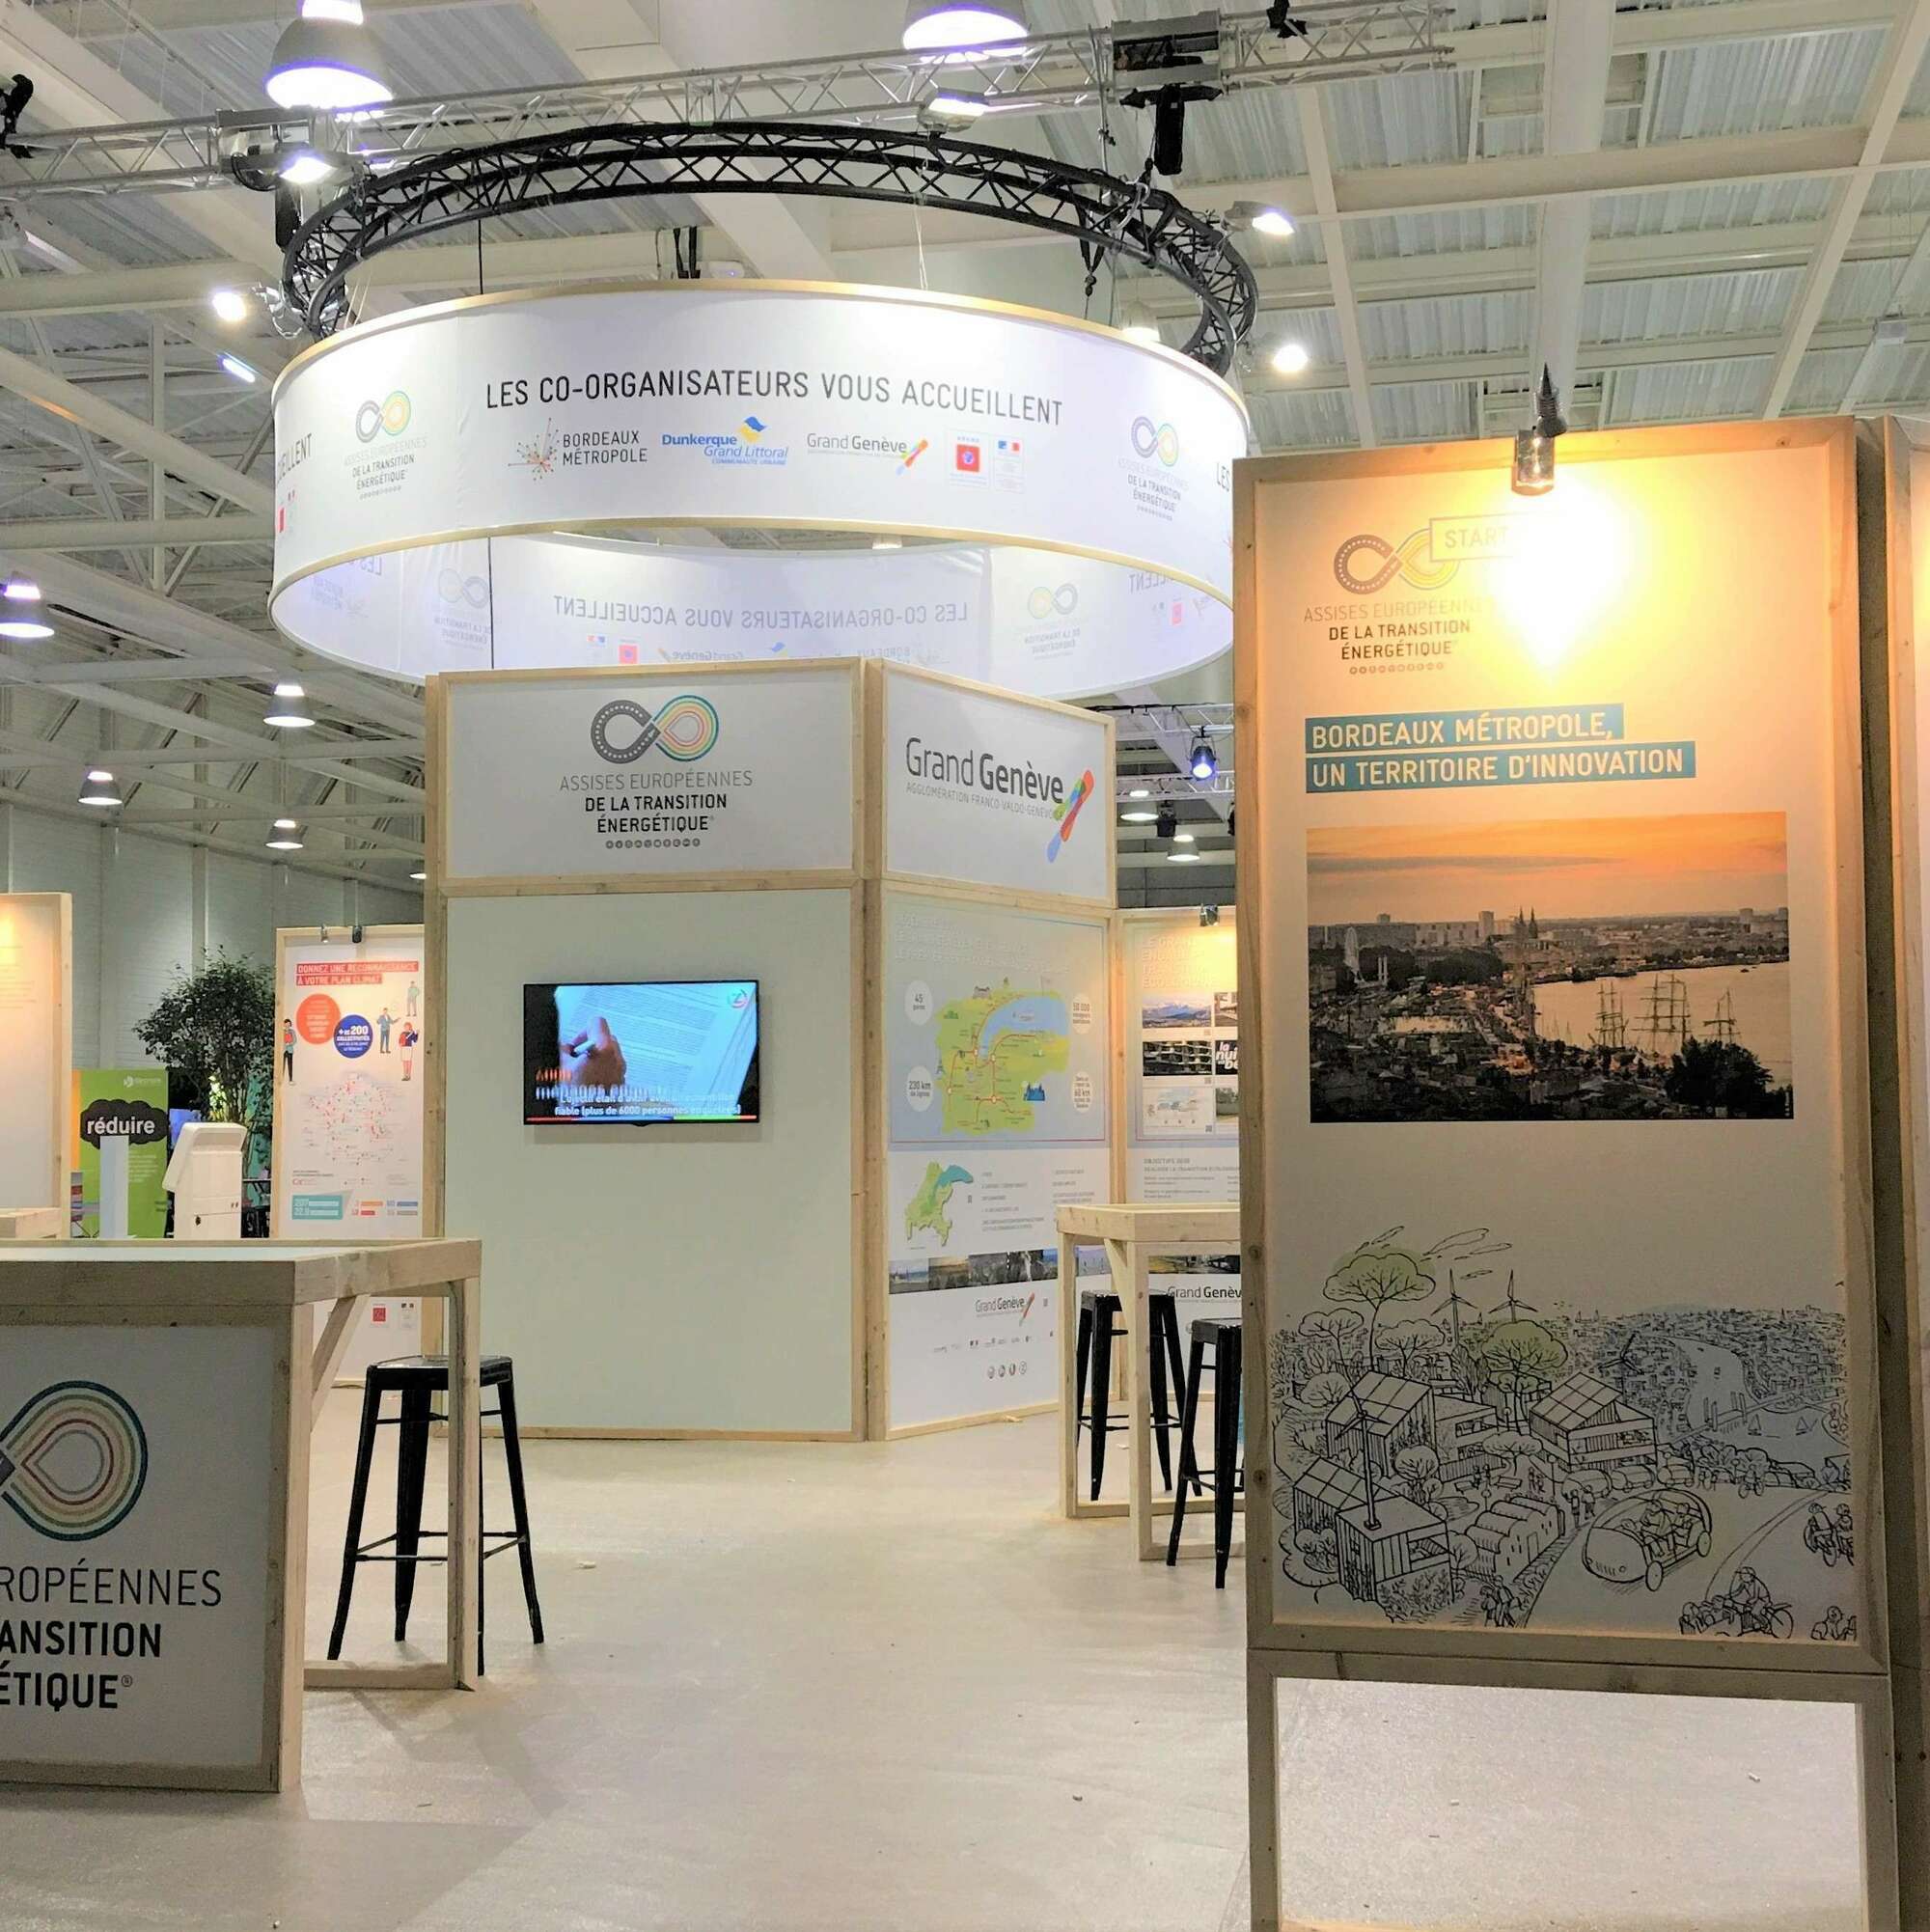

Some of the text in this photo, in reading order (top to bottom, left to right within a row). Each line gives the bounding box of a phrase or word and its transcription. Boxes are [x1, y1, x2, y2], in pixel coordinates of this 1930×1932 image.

[487, 369, 1063, 427] LES CO-ORGANISATEURS VOUS ACCUEILLENT
[563, 430, 640, 449] BORDEAUX
[662, 433, 737, 448] Dunkerque
[807, 432, 907, 454] Grand Genève
[563, 447, 648, 466] MÉTROPOLE
[703, 445, 788, 458] Grand Littoral
[352, 454, 415, 478] DE LA TRANSITION
[1217, 461, 1230, 492] LES
[1147, 481, 1181, 501] TRANSITION
[1444, 525, 1509, 549] START
[1304, 603, 1368, 622] ASSISES
[1329, 619, 1472, 641] DE LA TRANSITION
[1340, 639, 1452, 660] ÉNERGÉTIQUE
[1311, 711, 1613, 750] BORDEAUX MÉTROPOLE,
[905, 736, 1064, 804] Grand Genève
[1311, 748, 1684, 787] UN TERRITOIRE D'INNOVATION
[559, 768, 754, 791] ASSISES EUROPÉENNES
[585, 793, 728, 813] DE LA TRANSITION
[596, 812, 709, 834] ÉNERGÉTIQUE
[350, 1025, 369, 1035] 200
[1219, 1041, 1230, 1052] la
[605, 1106, 618, 1116] de
[87, 1117, 155, 1135] réduire
[1167, 1285, 1201, 1298] Grand
[975, 1299, 996, 1313] Grand
[0, 1558, 222, 1607] ROPÉENNES
[0, 1619, 162, 1658] ANSITION
